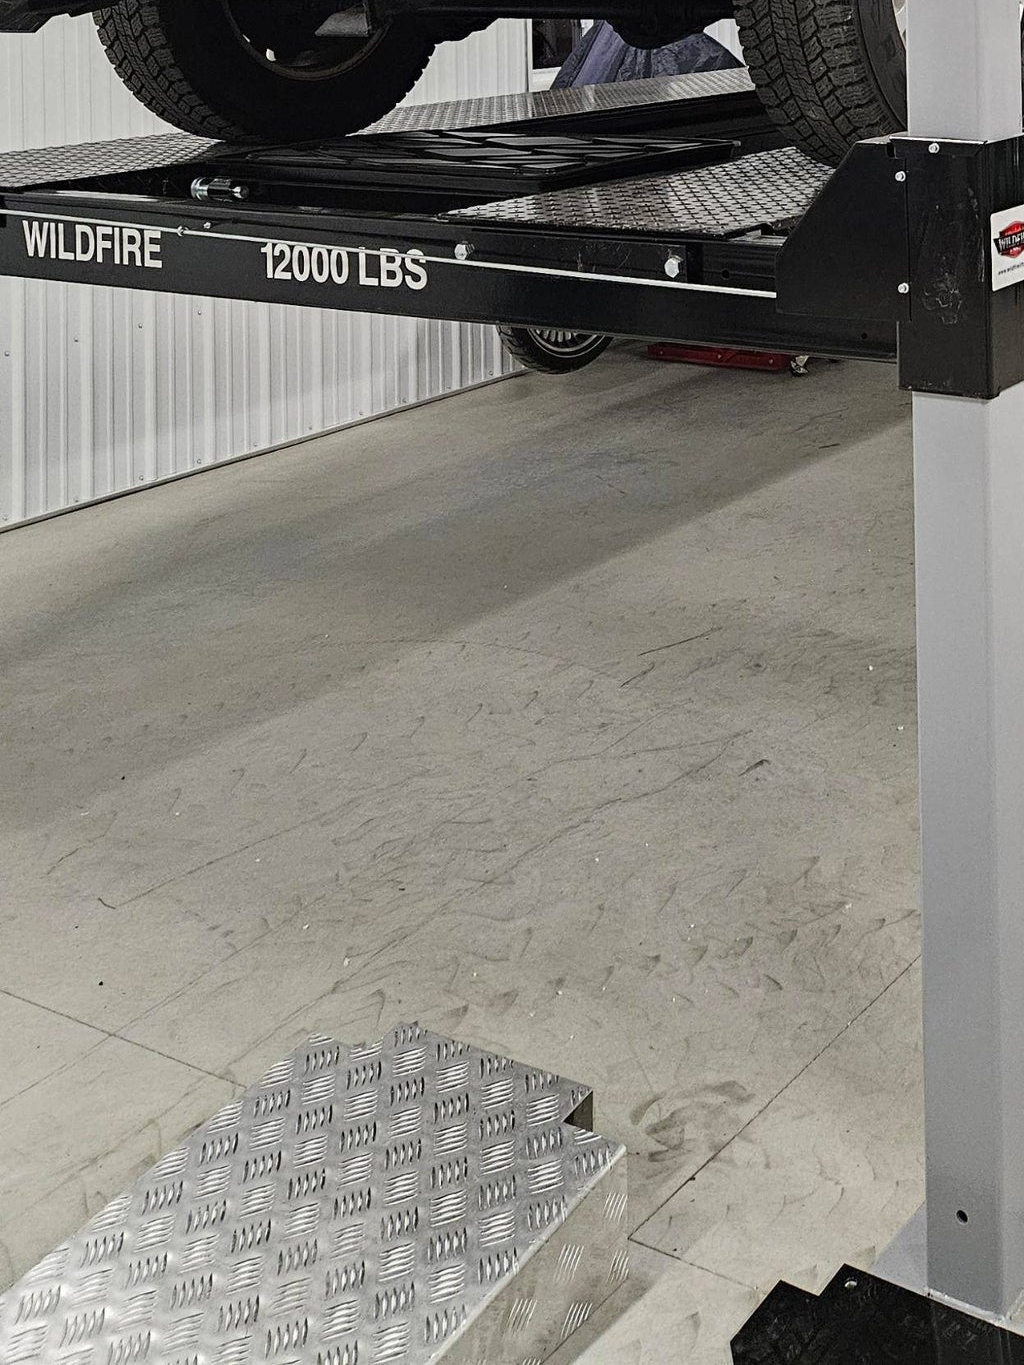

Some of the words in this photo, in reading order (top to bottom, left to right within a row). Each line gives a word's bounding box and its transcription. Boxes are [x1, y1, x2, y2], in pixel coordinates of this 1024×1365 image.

[22, 219, 163, 268] WILDFIRE
[261, 242, 348, 284] 12000
[358, 246, 428, 291] LBS
